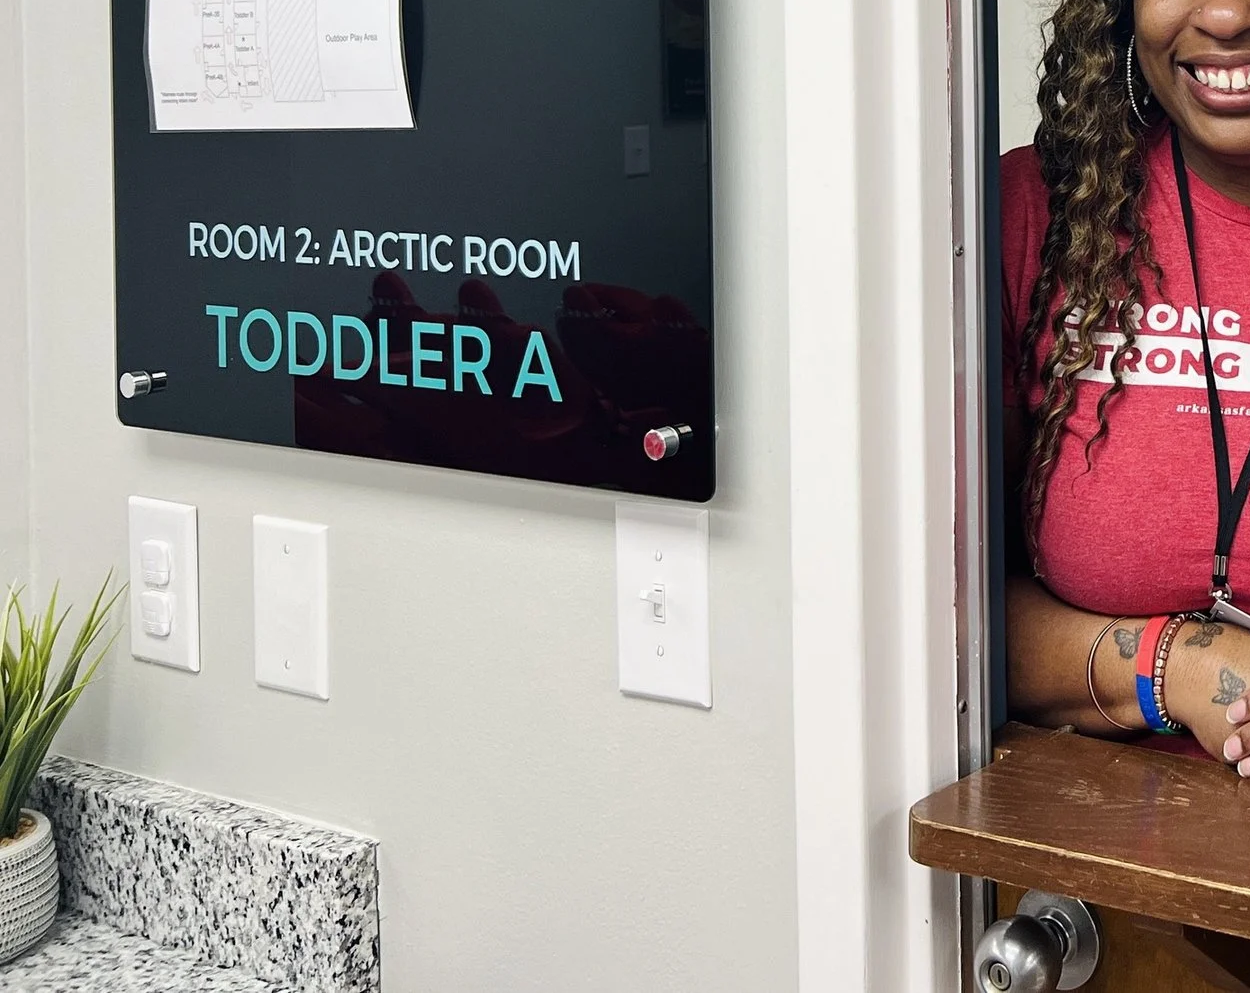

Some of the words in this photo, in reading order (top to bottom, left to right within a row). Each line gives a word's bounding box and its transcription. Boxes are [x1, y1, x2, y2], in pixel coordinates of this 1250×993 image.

[325, 34, 349, 43] Outdoor
[349, 32, 363, 43] Play
[364, 33, 378, 42] Area
[188, 221, 286, 263] ROOM
[294, 227, 321, 265] 2:
[328, 228, 454, 273] ARCTIC
[463, 236, 581, 281] ROOM
[206, 304, 493, 396] TODDLER
[512, 330, 563, 403] A
